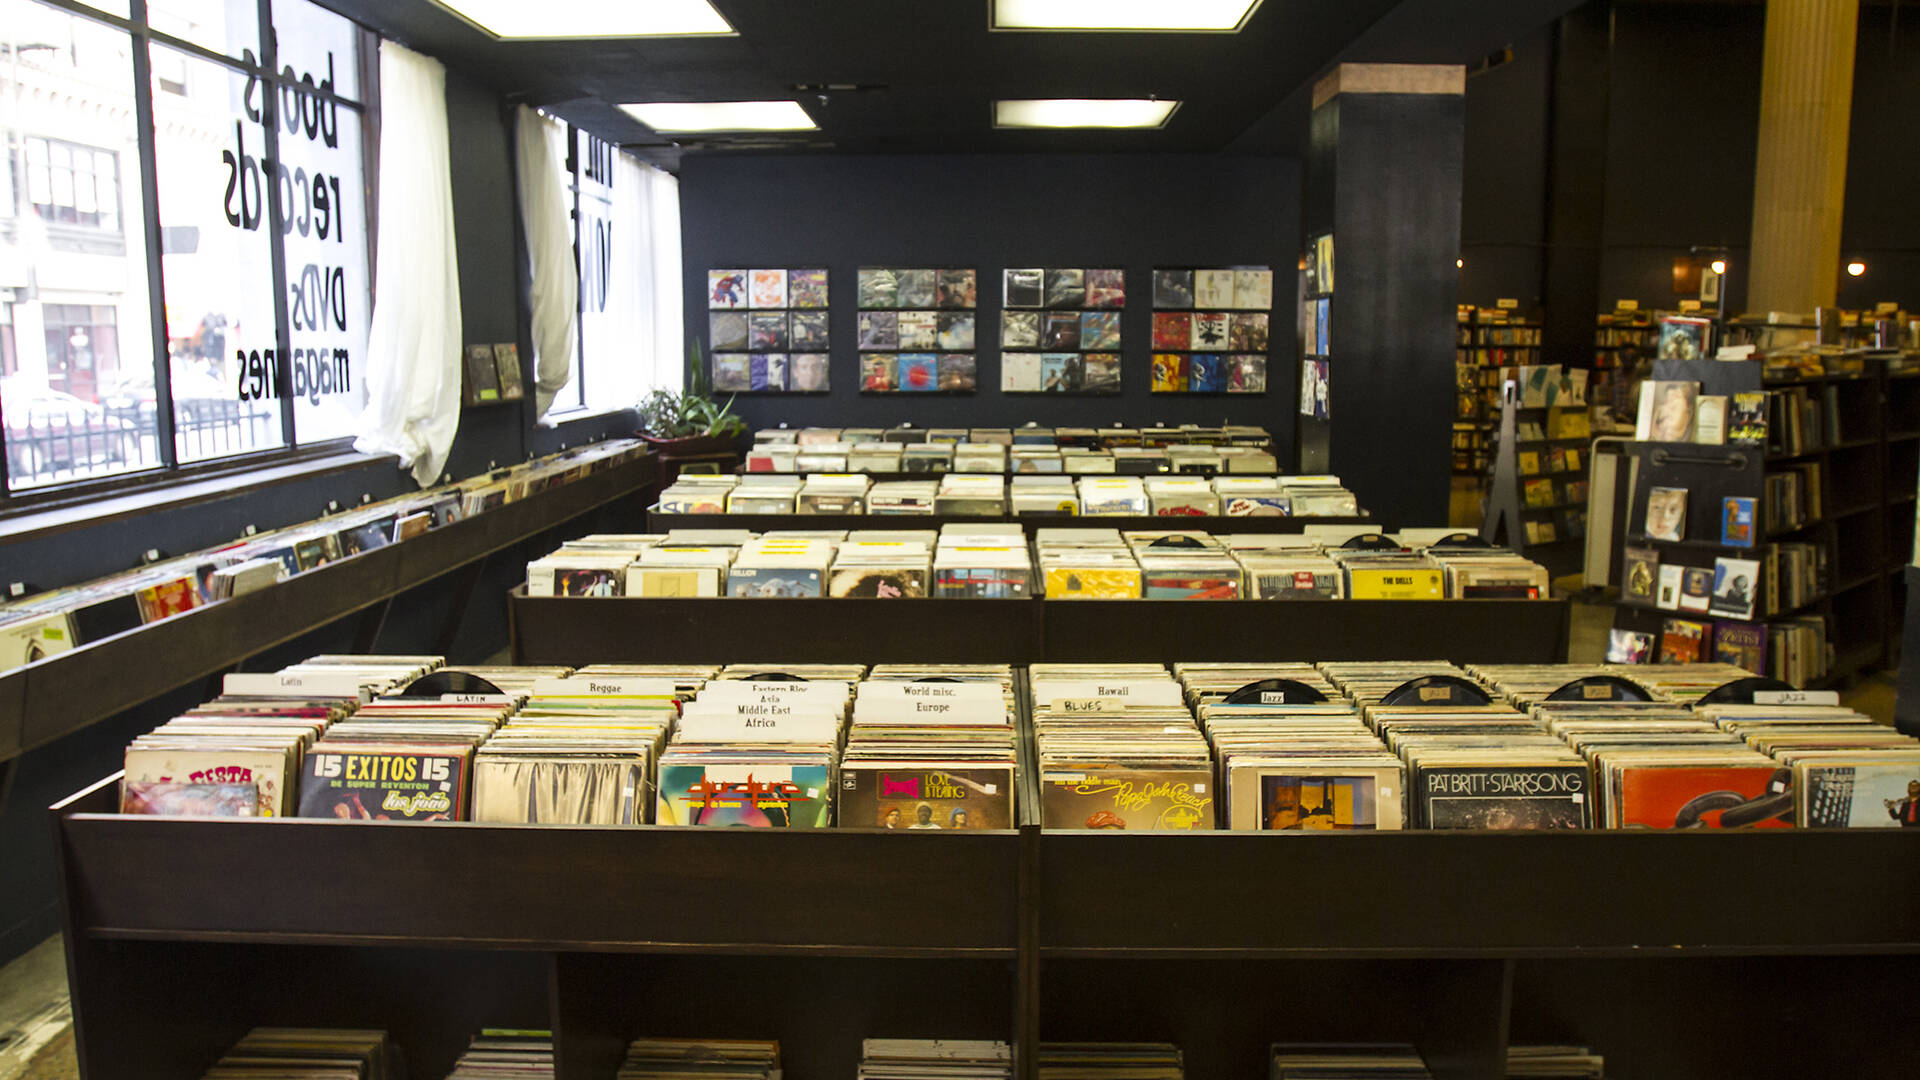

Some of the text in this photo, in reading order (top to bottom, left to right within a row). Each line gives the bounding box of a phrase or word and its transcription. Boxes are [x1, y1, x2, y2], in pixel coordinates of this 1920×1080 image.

[281, 677, 303, 687] Latin
[590, 682, 622, 694] Reggae
[903, 686, 957, 697] World misc.
[1098, 686, 1129, 696] Hawaii
[1263, 692, 1283, 702] Jazz
[738, 705, 791, 715] Middle East
[916, 702, 950, 714] Europe
[1064, 701, 1102, 711] BLUES
[745, 718, 776, 728] Africa
[314, 754, 450, 781] 15 EXITOS 15
[925, 773, 951, 786] LOVE
[1429, 773, 1449, 792] PAT
[330, 780, 342, 788] DE
[381, 781, 430, 790] REVENTON
